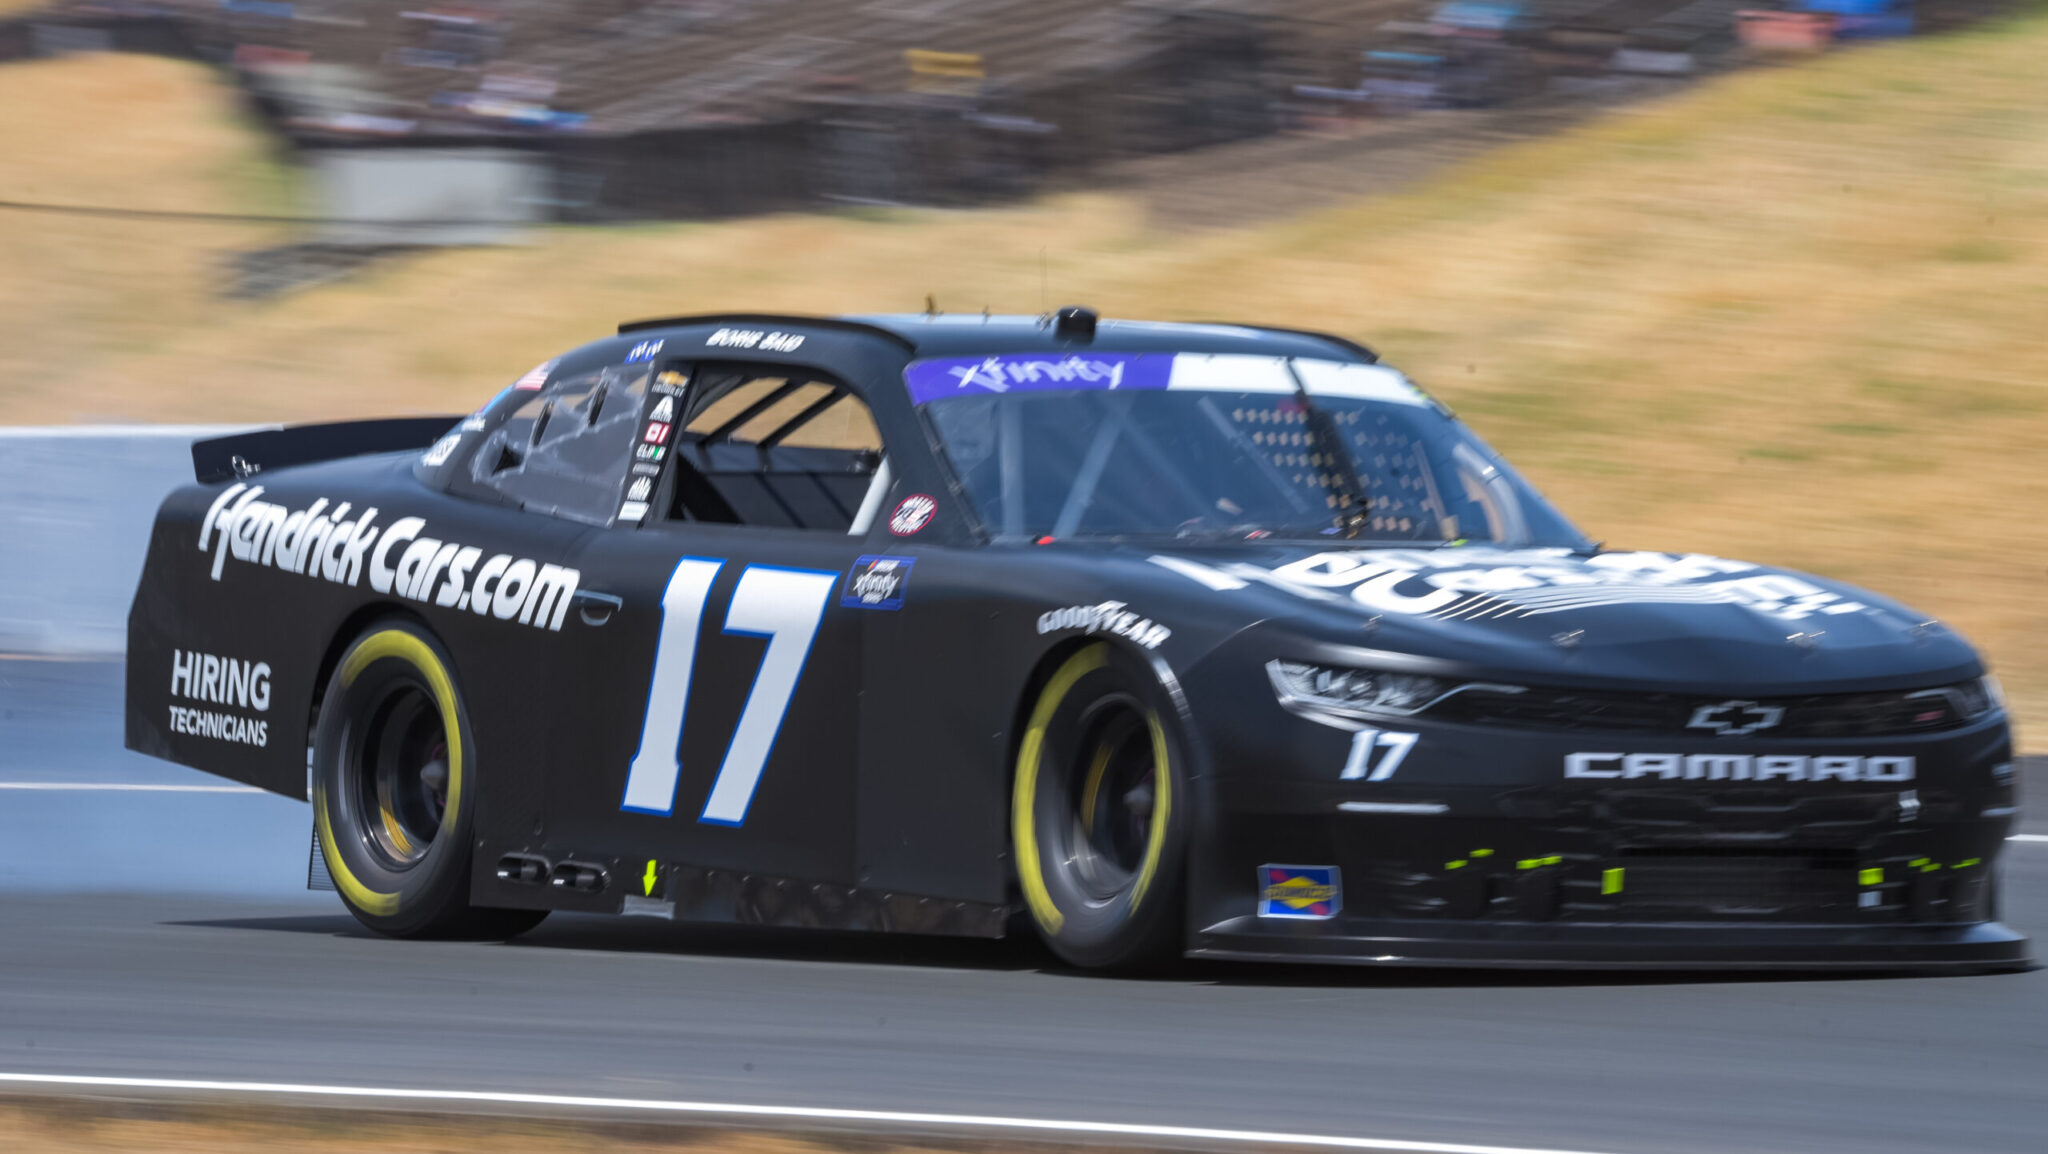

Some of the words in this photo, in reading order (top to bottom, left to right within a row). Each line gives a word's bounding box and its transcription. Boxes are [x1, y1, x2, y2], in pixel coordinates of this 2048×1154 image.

[198, 483, 581, 632] HendrickCars.com
[171, 649, 271, 711] HIRING
[619, 554, 843, 829] 17
[169, 706, 268, 748] TECHNICIANS
[1340, 729, 1420, 780] 17
[1564, 751, 1917, 782] CAMARO
